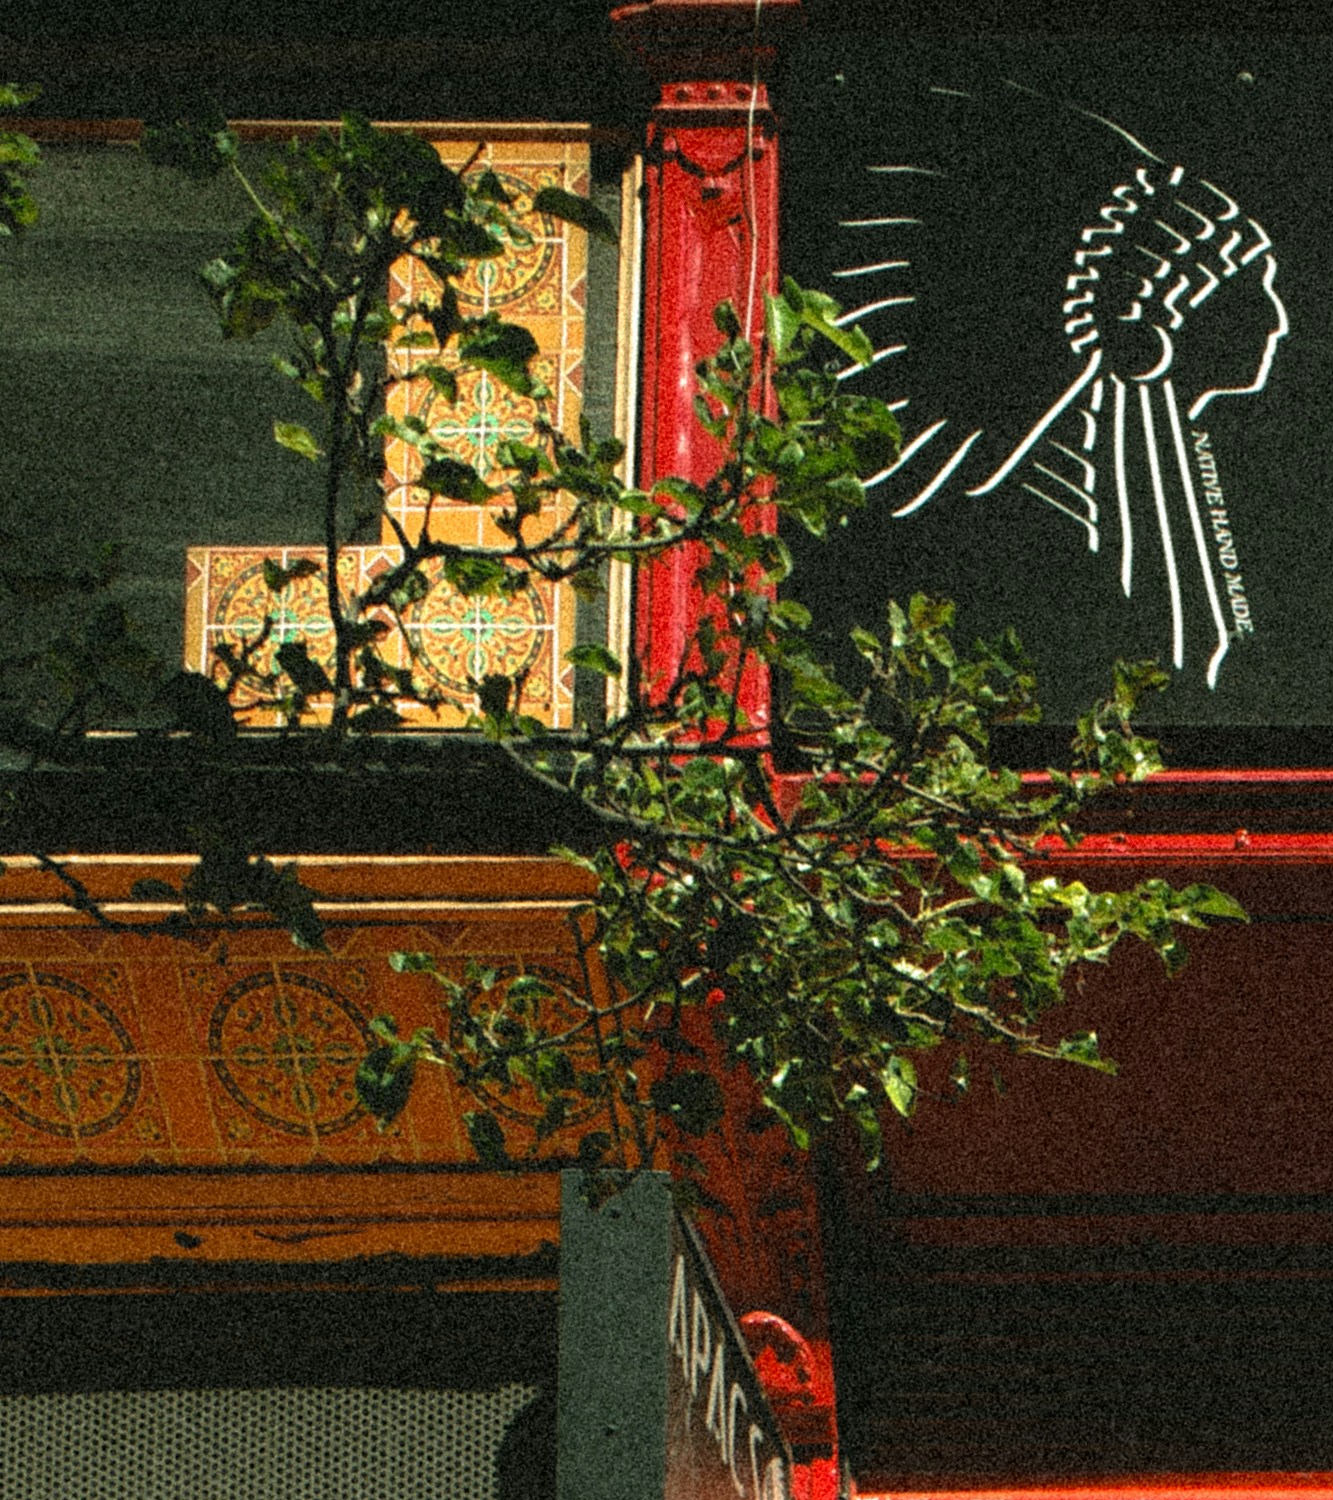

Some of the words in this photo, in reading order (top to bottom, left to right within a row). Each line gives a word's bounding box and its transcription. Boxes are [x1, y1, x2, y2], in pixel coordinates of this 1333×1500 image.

[1191, 427, 1224, 506] NATIVE
[1210, 507, 1239, 571] HAND
[1225, 571, 1254, 634] MADE
